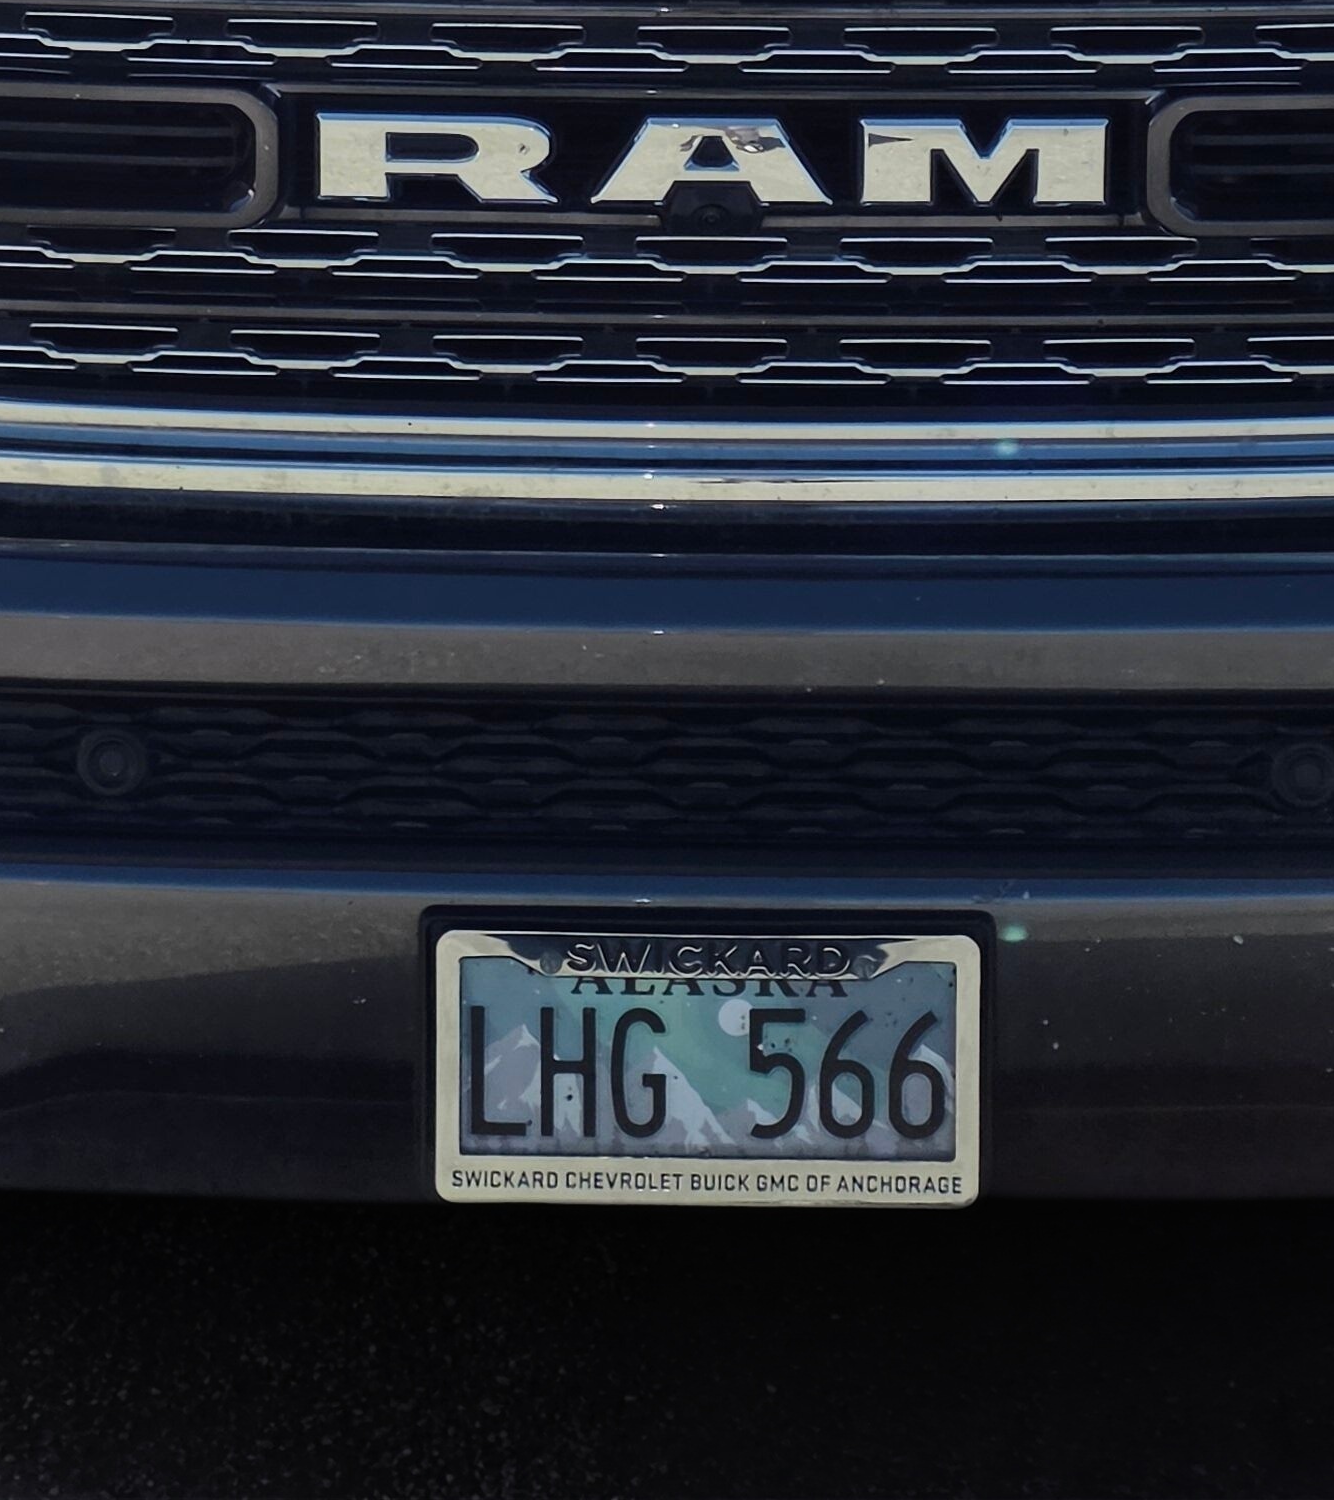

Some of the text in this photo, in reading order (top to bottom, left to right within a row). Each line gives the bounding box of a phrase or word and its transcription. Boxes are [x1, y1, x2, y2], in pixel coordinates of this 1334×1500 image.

[316, 112, 1108, 205] RAM
[566, 942, 851, 978] SWICKARD
[469, 1006, 946, 1140] LHG 566
[451, 1170, 962, 1194] SWICKARD CHEVROLET BUICK GMC OF ANCHORAGE
